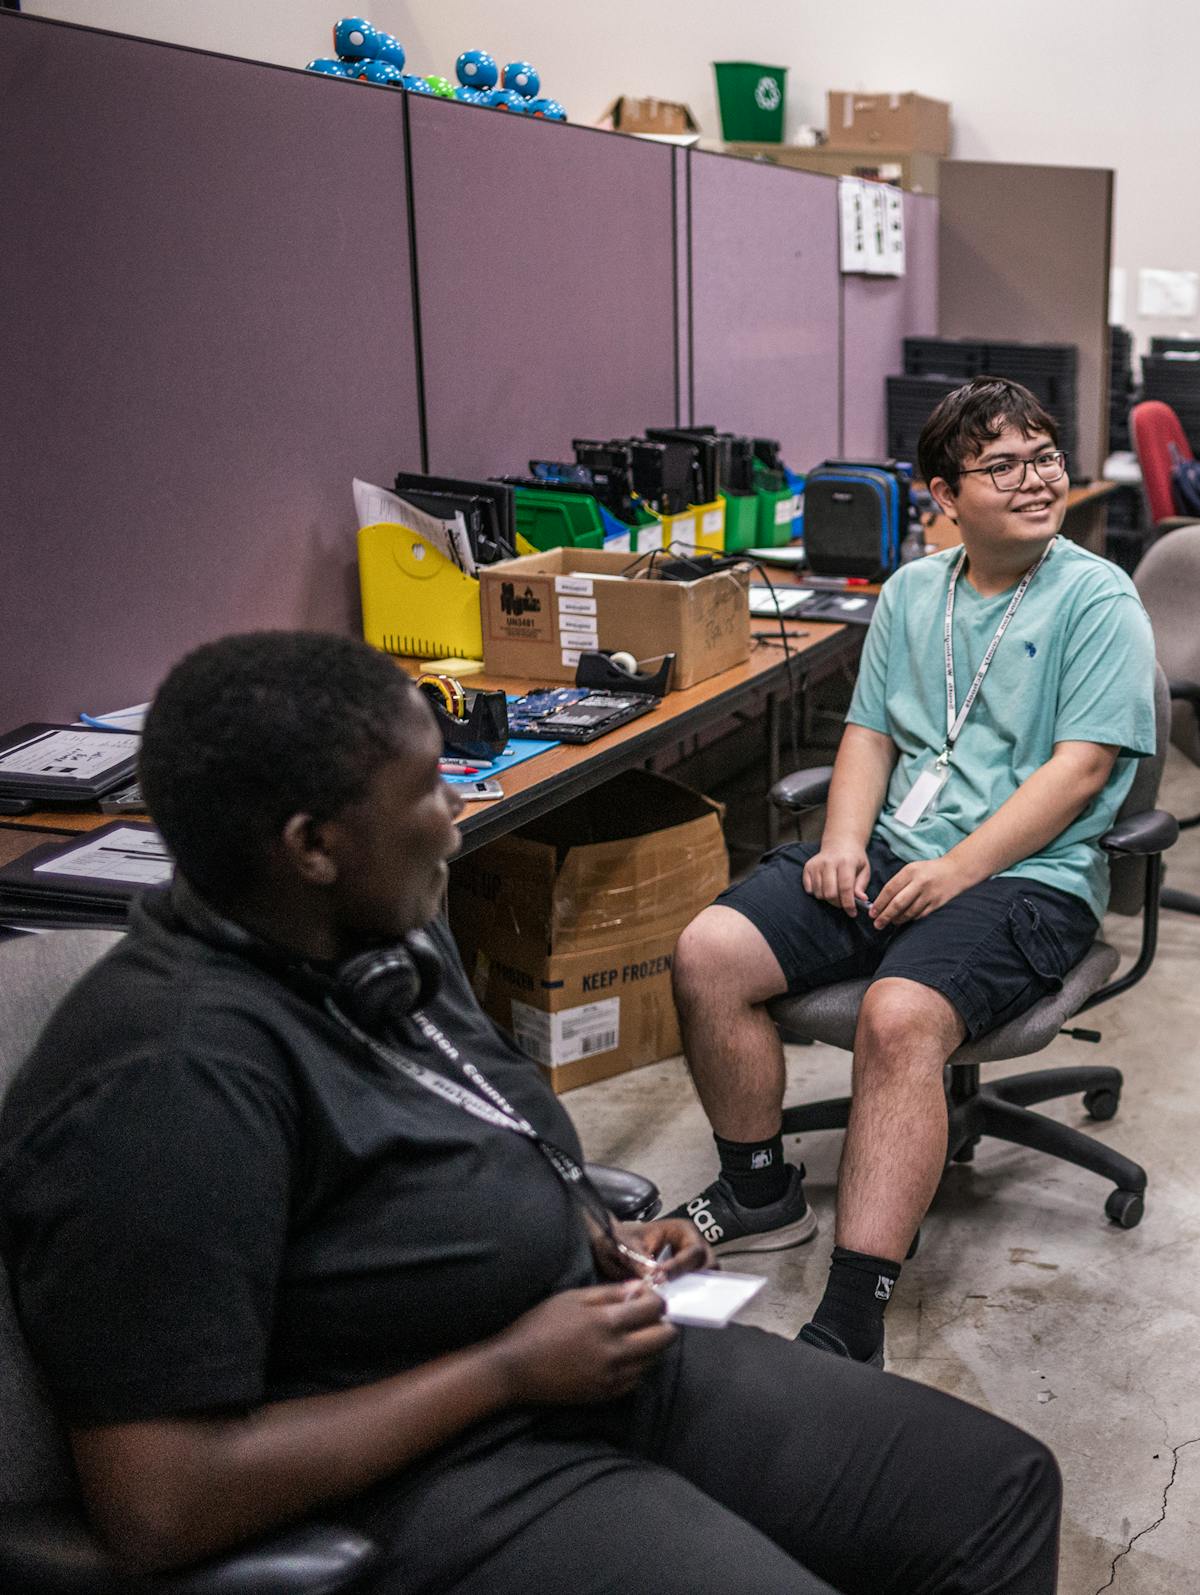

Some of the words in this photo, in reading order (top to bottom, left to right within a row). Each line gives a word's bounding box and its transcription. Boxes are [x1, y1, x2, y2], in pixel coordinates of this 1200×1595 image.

[582, 969, 619, 993] KEEP
[622, 953, 673, 983] FROZEN
[411, 1008, 460, 1061] ington
[462, 1062, 515, 1114] County
[686, 1197, 724, 1244] das
